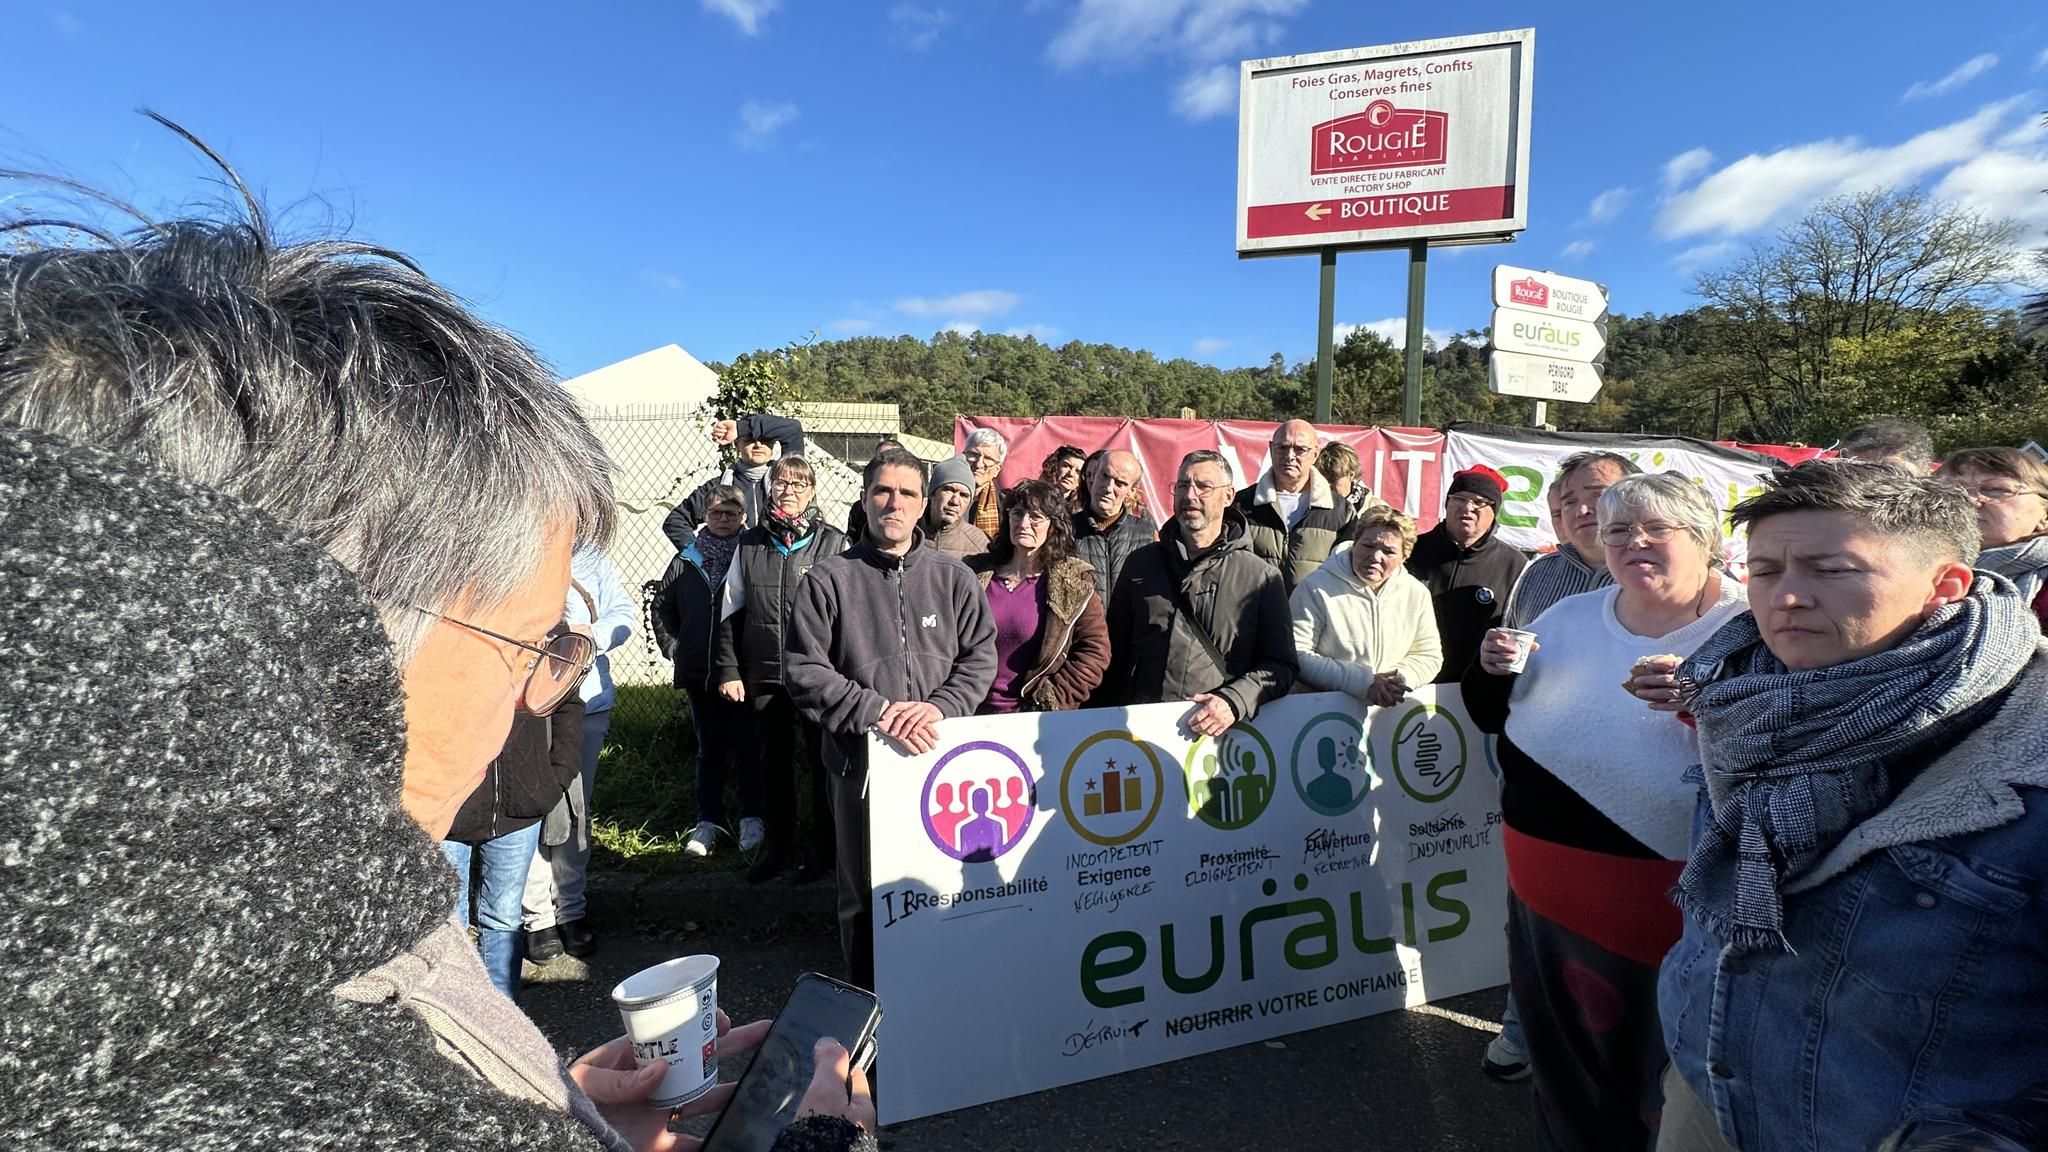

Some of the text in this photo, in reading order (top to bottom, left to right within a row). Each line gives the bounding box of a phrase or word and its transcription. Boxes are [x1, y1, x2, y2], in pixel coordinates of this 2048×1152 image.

[1292, 59, 1474, 89] Foies Gras, Magrets, Confits
[1329, 81, 1432, 101] Conserves fines
[1310, 167, 1446, 187] VENTE DIRECTE DU FABRICANT
[1344, 180, 1412, 195] FACTORY SHOP
[1341, 194, 1450, 219] BOUTIQUE
[1552, 289, 1589, 304] BOUTIQUE
[1078, 865, 1152, 886] Exigence
[1165, 967, 1419, 1038] NOURRIR VOTRE CONFIANCE
